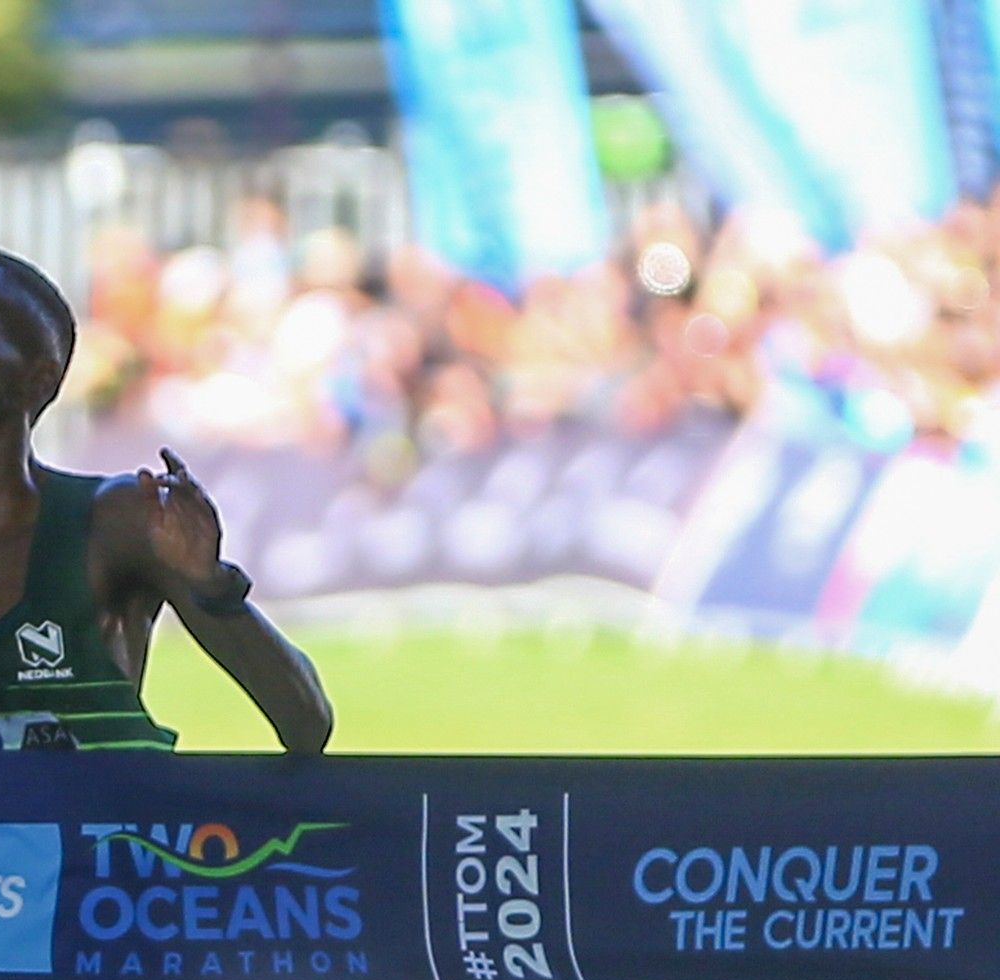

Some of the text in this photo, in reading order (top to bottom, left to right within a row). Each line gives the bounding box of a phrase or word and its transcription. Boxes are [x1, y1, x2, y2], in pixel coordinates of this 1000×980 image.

[17, 667, 74, 681] NEDBNK
[81, 823, 240, 879] TWO
[633, 845, 939, 903] CONQUER
[79, 886, 363, 941] OCEANS
[456, 815, 498, 980] #TTOM
[496, 808, 553, 979] 2024
[668, 907, 965, 950] THE CURRENT
[75, 951, 369, 976] MARATHON
